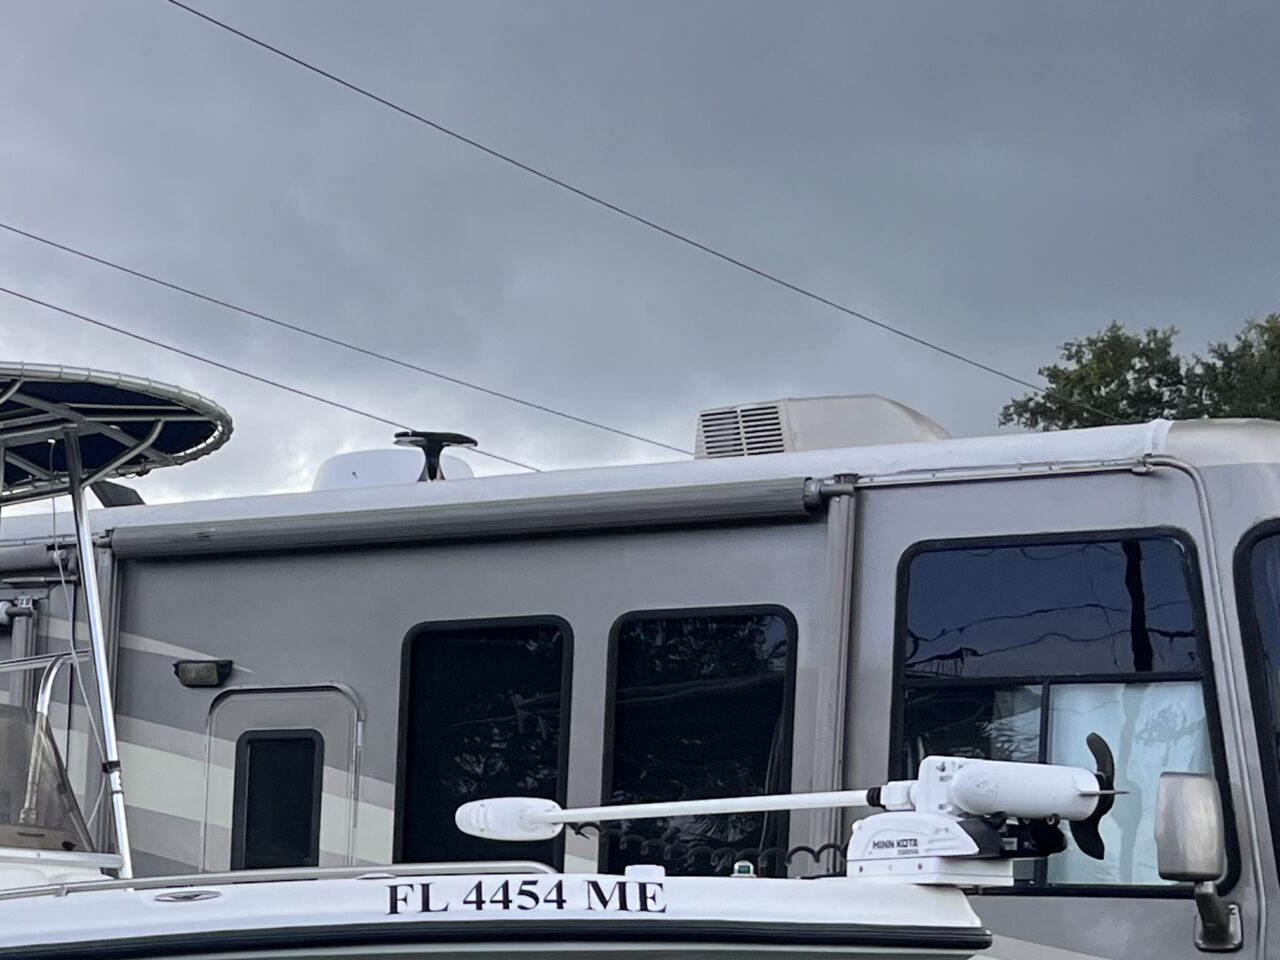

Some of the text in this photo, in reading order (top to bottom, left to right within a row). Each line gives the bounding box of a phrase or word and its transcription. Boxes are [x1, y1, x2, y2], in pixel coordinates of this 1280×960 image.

[386, 879, 667, 915] FL 4454 ME
